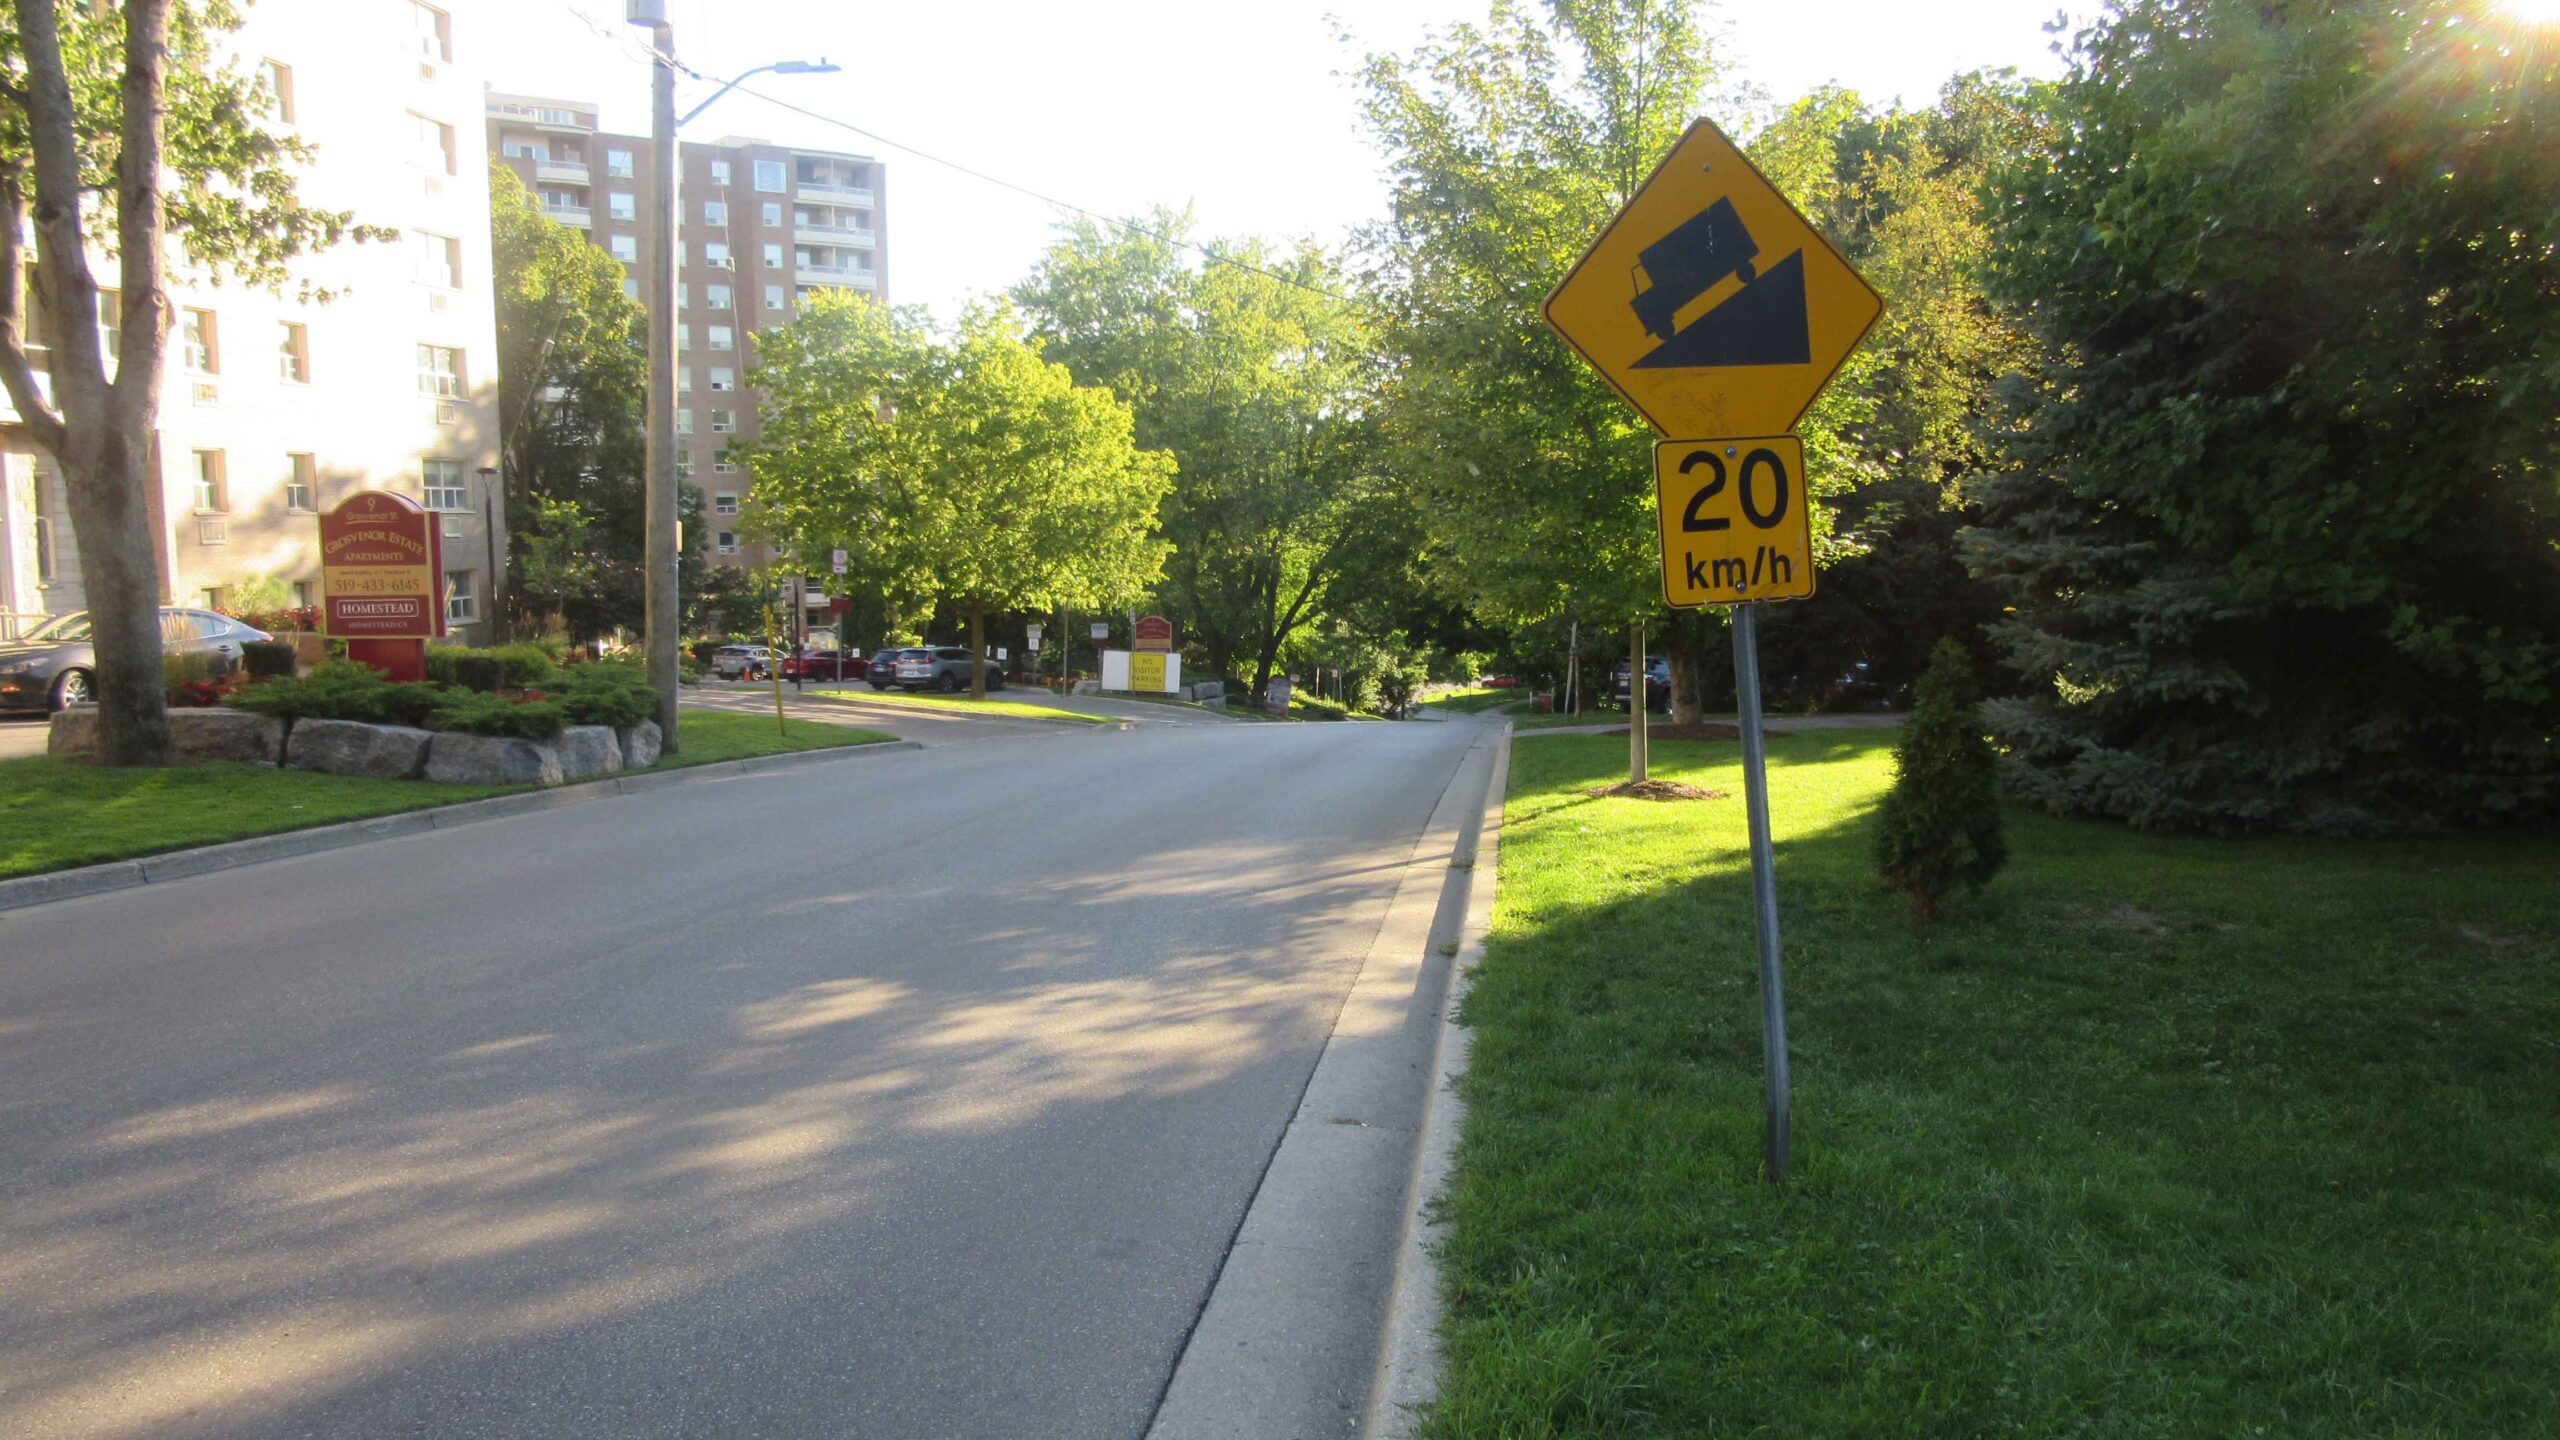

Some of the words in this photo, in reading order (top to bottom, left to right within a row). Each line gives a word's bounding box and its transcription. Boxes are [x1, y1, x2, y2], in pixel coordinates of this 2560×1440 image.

[1678, 448, 1789, 533] 20
[367, 497, 376, 512] 9
[325, 530, 386, 554] GROSVENOR
[389, 531, 425, 557] ESTATE
[345, 552, 404, 561] APARTMENTS
[1685, 545, 1792, 590] km/h
[335, 579, 420, 592] 519-433-6145
[342, 603, 414, 614] HOMESTEAD
